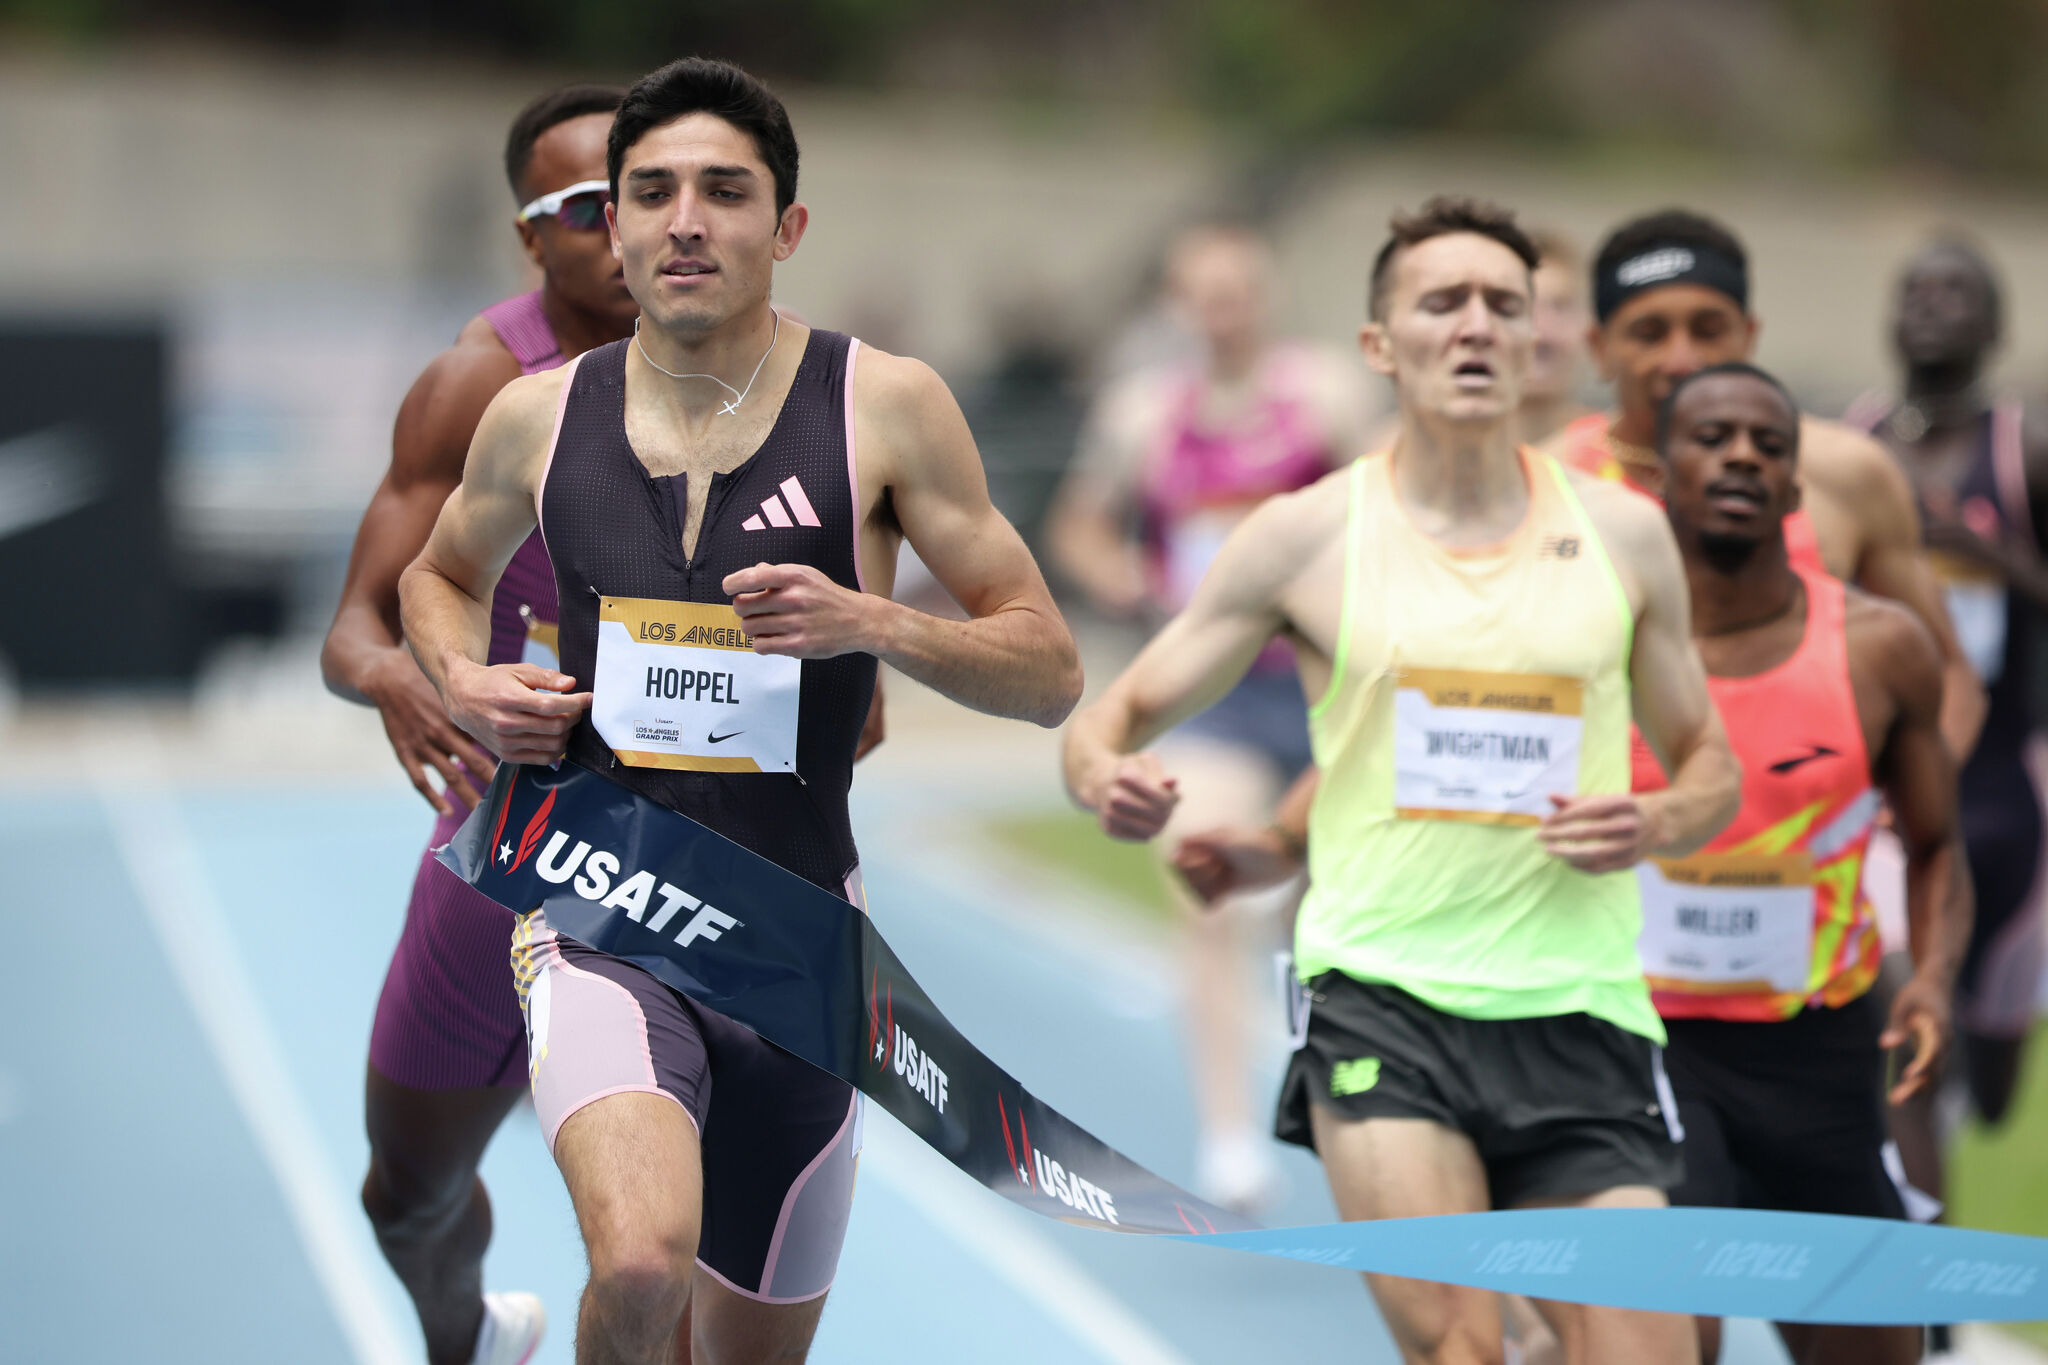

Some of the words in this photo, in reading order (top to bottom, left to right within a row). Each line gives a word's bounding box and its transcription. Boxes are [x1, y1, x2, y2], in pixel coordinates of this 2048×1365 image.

[639, 621, 677, 642] LOS
[679, 625, 754, 649] ANGELE
[645, 666, 740, 705] HOPPEL
[635, 726, 648, 734] LOS
[653, 728, 680, 736] ANGELES
[635, 733, 661, 741] GRAND
[1425, 729, 1550, 764] WIGHTMAN
[535, 830, 738, 948] USATF
[1676, 906, 1759, 938] MILLER
[894, 1023, 949, 1115] USATF
[1033, 1148, 1119, 1226] USATF
